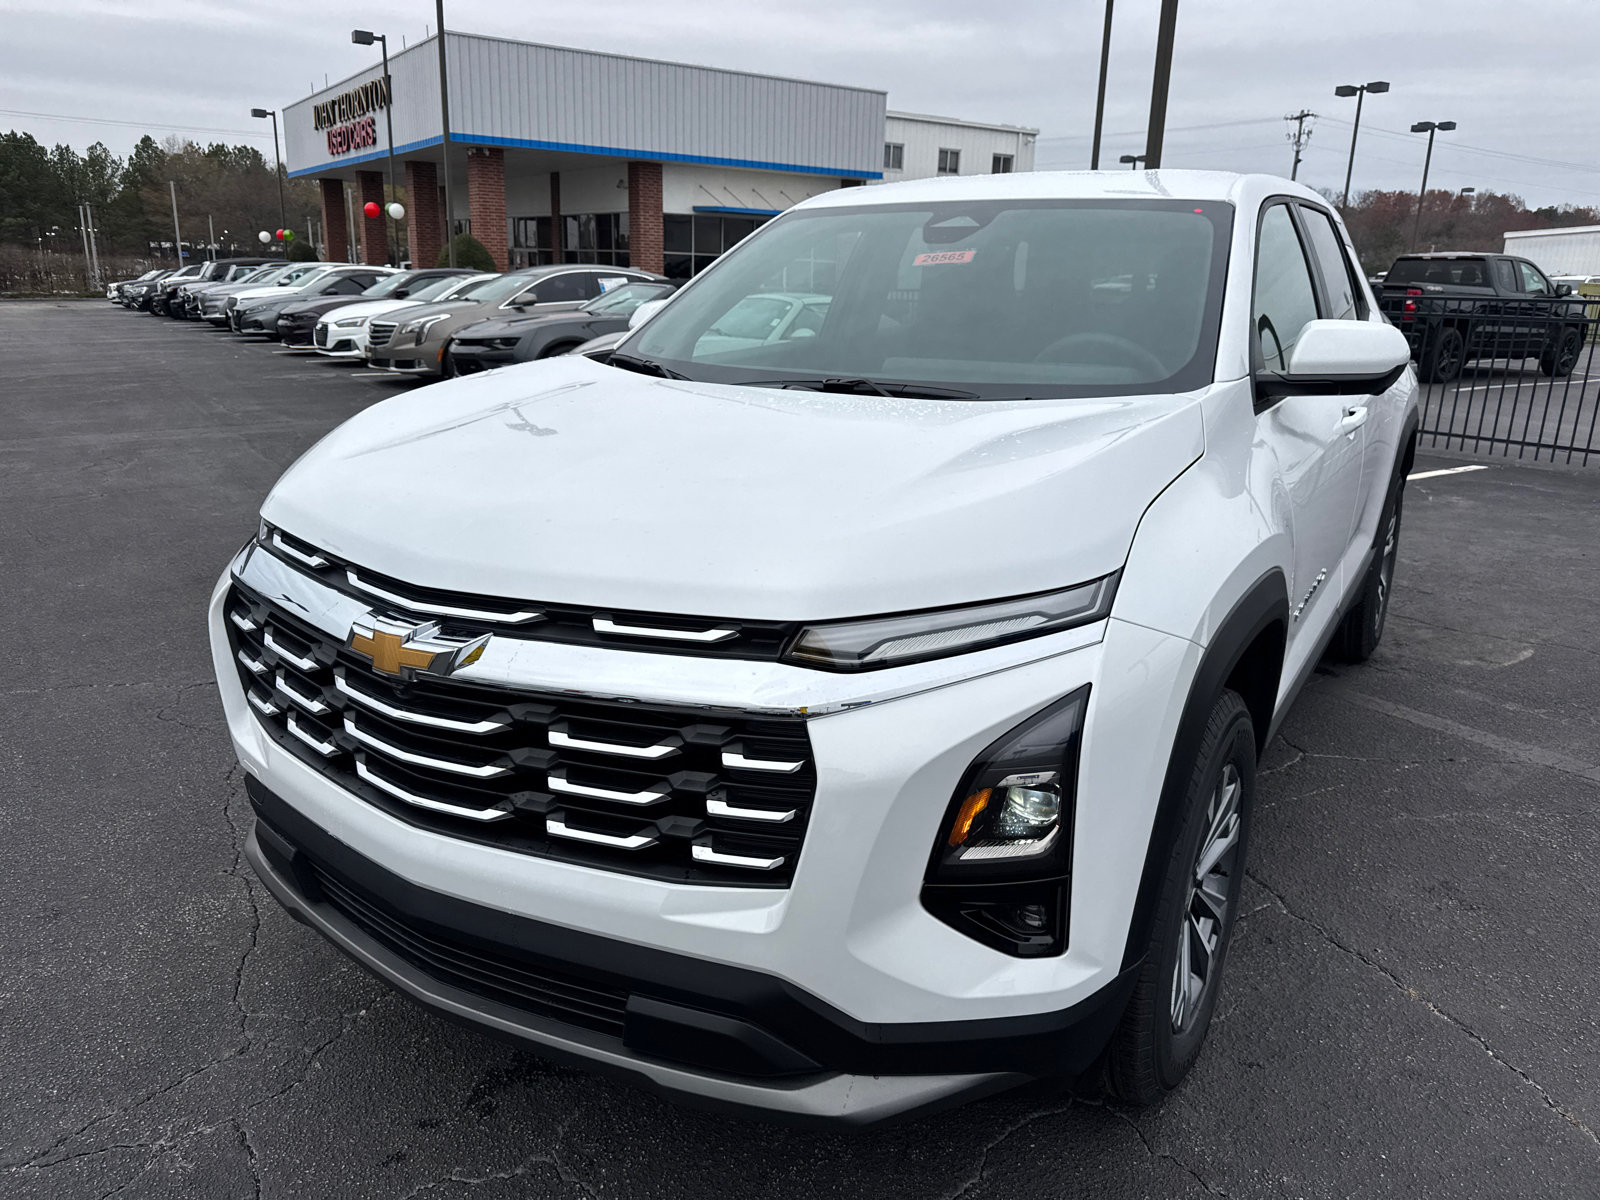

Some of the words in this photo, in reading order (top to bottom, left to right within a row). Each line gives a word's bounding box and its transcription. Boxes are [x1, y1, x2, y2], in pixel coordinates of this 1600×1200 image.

[312, 99, 336, 130] JOHN
[334, 75, 392, 122] THORNTON
[326, 125, 349, 155] USED
[349, 116, 376, 149] CARS
[921, 252, 966, 263] 26565
